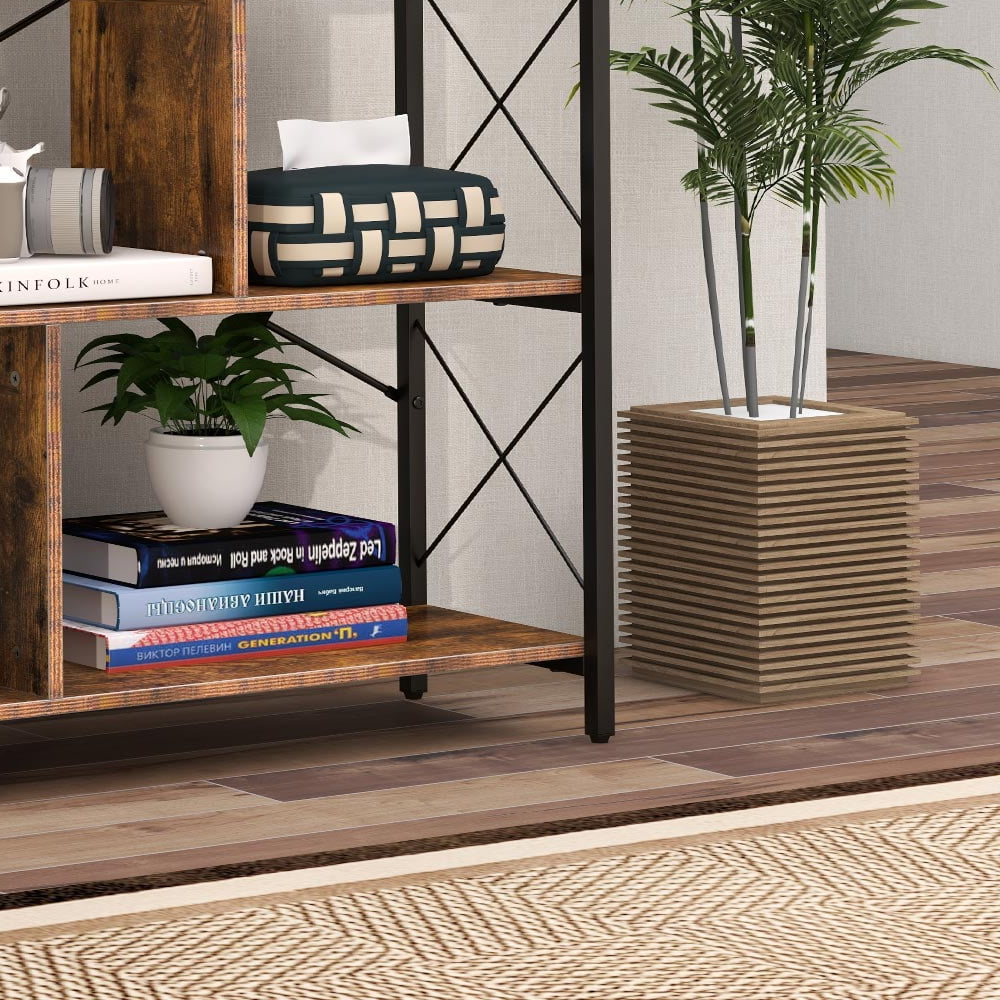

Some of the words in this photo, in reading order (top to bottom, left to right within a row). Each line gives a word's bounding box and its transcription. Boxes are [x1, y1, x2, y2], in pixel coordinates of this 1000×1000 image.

[93, 278, 120, 286] HOME
[250, 549, 268, 566] and
[269, 547, 295, 564] Rock
[295, 546, 305, 558] in
[308, 538, 357, 566] Zeppelin
[359, 539, 381, 561] Led
[230, 551, 249, 569] Roll
[146, 593, 251, 617] АВИАНОСЦЫ
[254, 588, 305, 607] НАШИ
[237, 632, 332, 650] GENERATION
[136, 647, 180, 662] ВИКТОР
[182, 642, 232, 657] ПЕЛЕВИН
